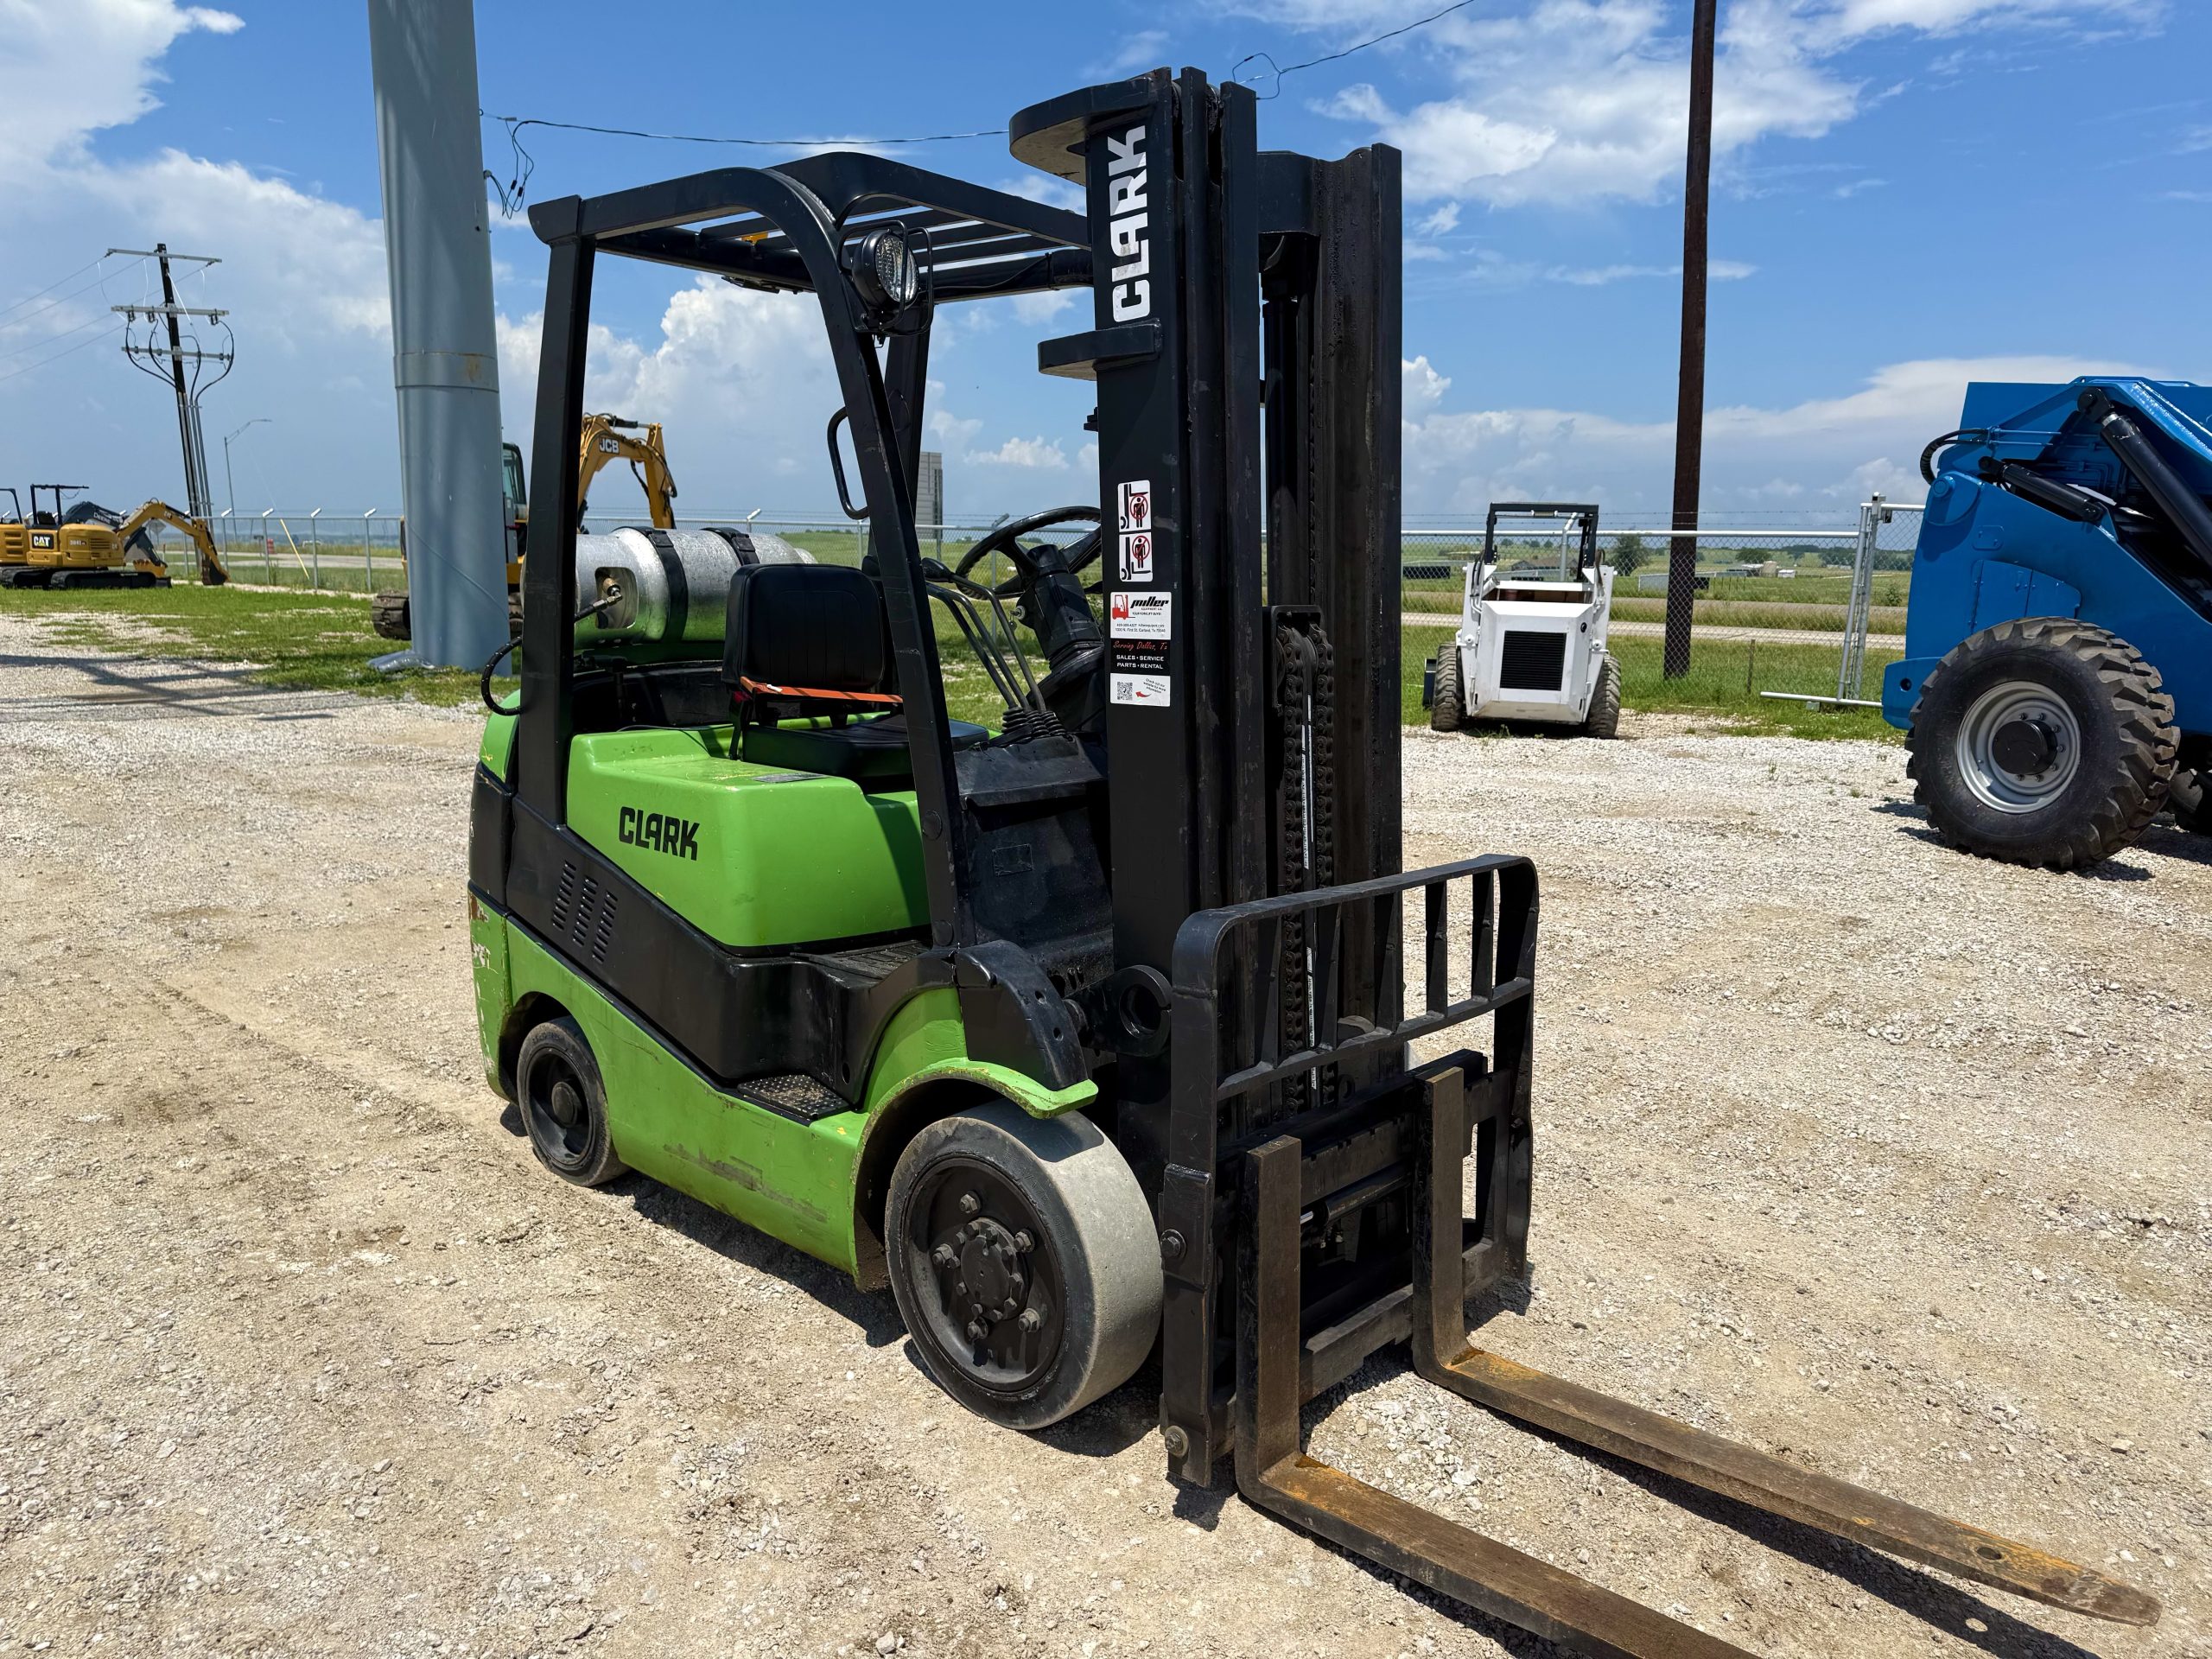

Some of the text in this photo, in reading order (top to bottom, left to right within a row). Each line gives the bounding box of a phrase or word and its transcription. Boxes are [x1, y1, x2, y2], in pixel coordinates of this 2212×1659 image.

[1107, 124, 1150, 322] CLARK
[599, 438, 620, 454] JCB
[34, 536, 50, 547] CAT
[1130, 596, 1169, 608] miller
[1113, 641, 1134, 652] Serving
